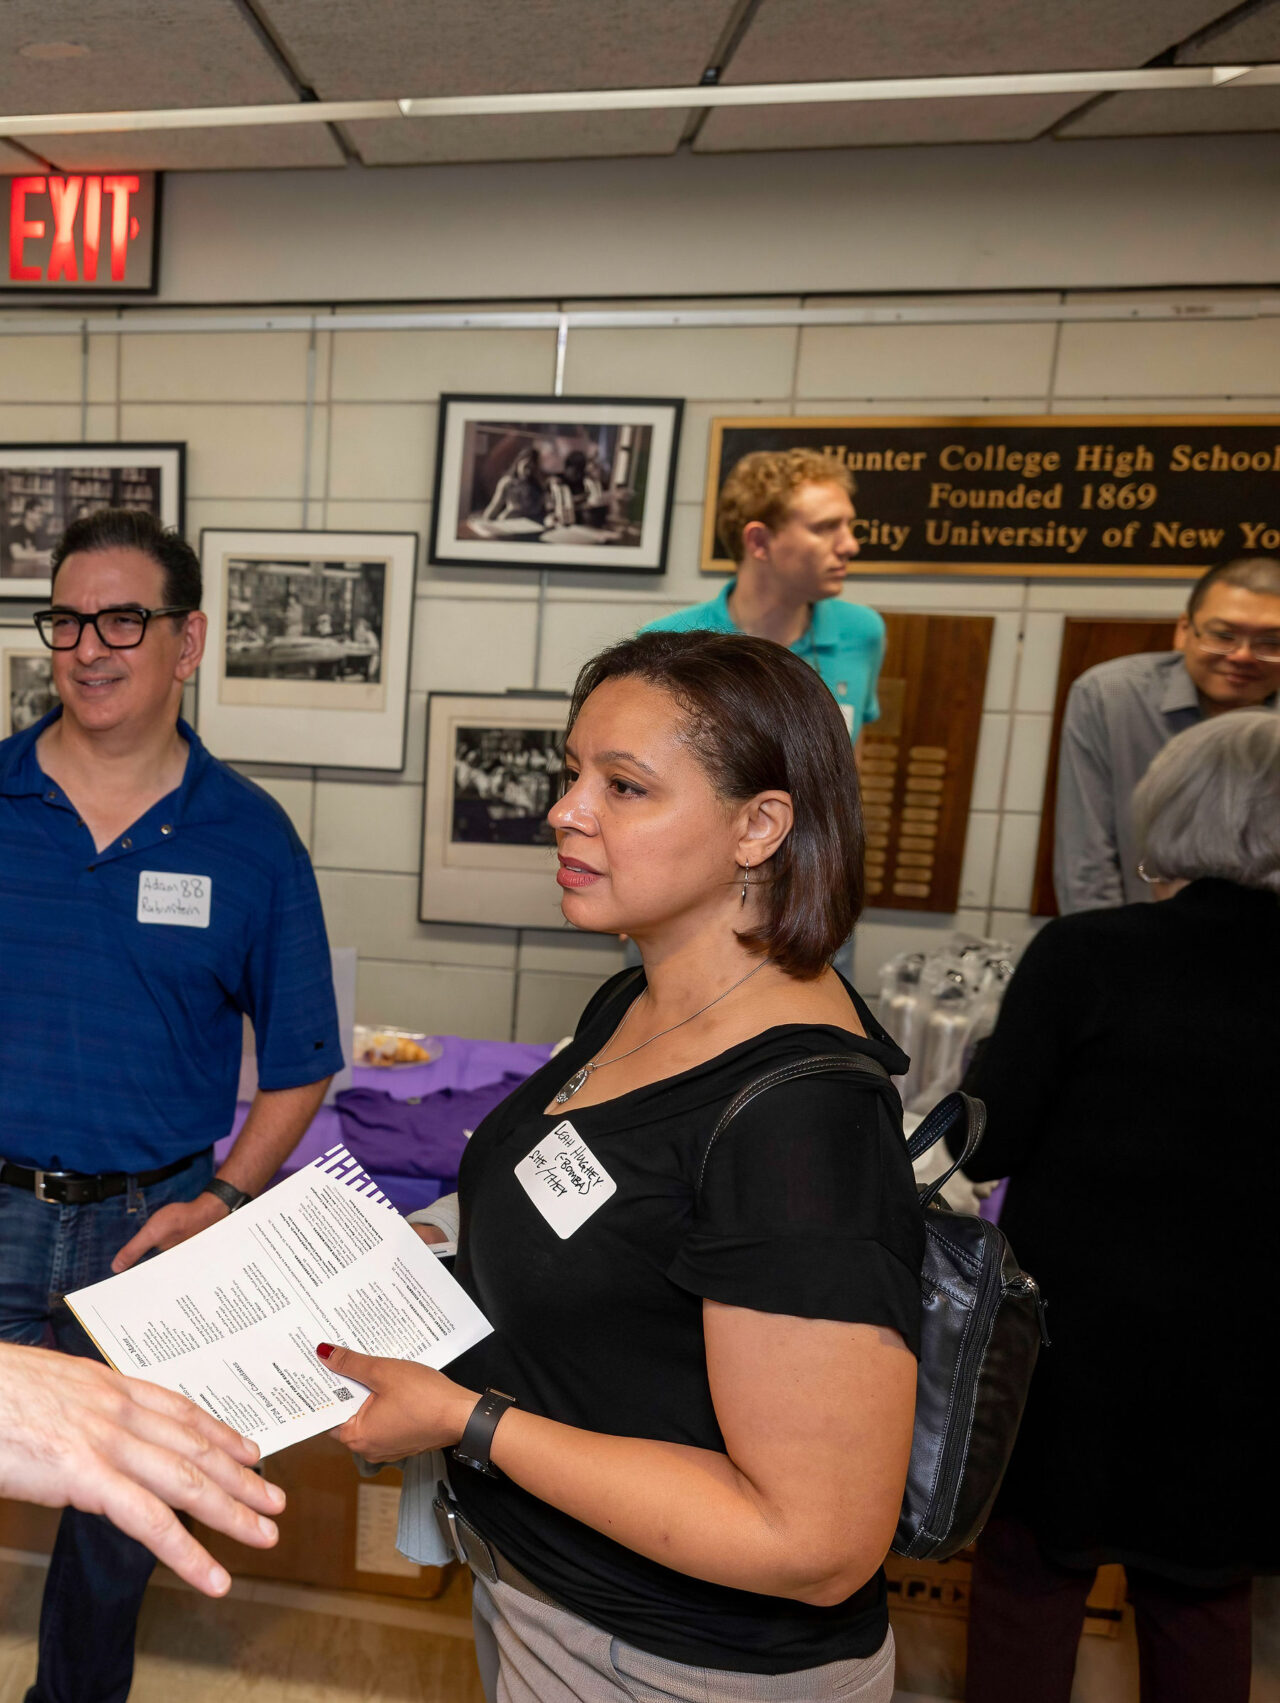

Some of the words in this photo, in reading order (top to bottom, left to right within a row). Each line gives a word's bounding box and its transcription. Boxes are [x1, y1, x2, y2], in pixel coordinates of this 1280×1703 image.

[9, 175, 140, 282] EXIT
[939, 444, 1061, 479] College
[1074, 444, 1155, 478] High
[1169, 444, 1280, 472] School
[928, 482, 1063, 509] Founded
[1080, 482, 1158, 510] 1869
[848, 519, 911, 551] City
[925, 519, 1088, 553] University
[1102, 520, 1141, 548] of
[1150, 521, 1225, 549] New
[179, 878, 204, 899] 88
[554, 1123, 575, 1148] LEAH
